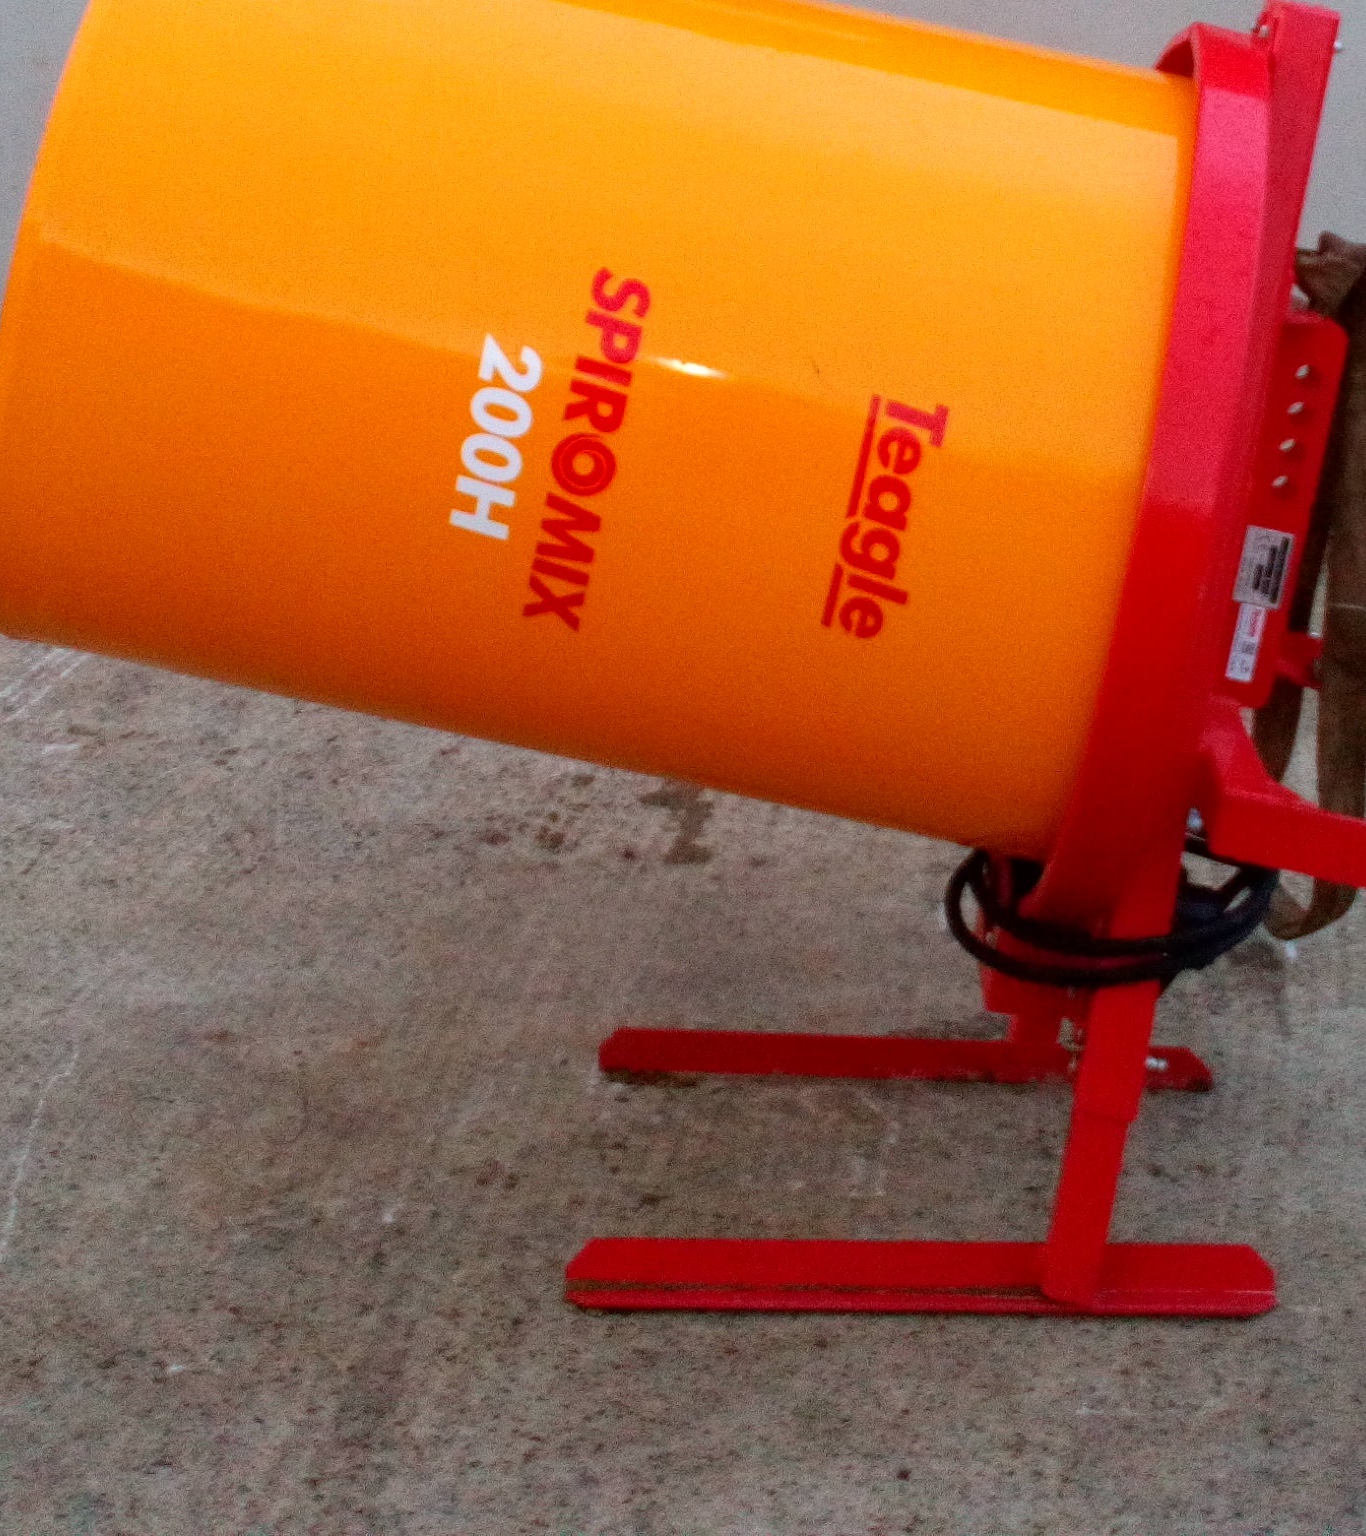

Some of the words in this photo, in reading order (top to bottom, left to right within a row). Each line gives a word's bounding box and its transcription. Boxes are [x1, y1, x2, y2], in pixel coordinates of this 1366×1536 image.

[448, 333, 543, 541] 200H
[523, 266, 651, 632] SPIROMIX
[838, 398, 950, 639] Teagle
